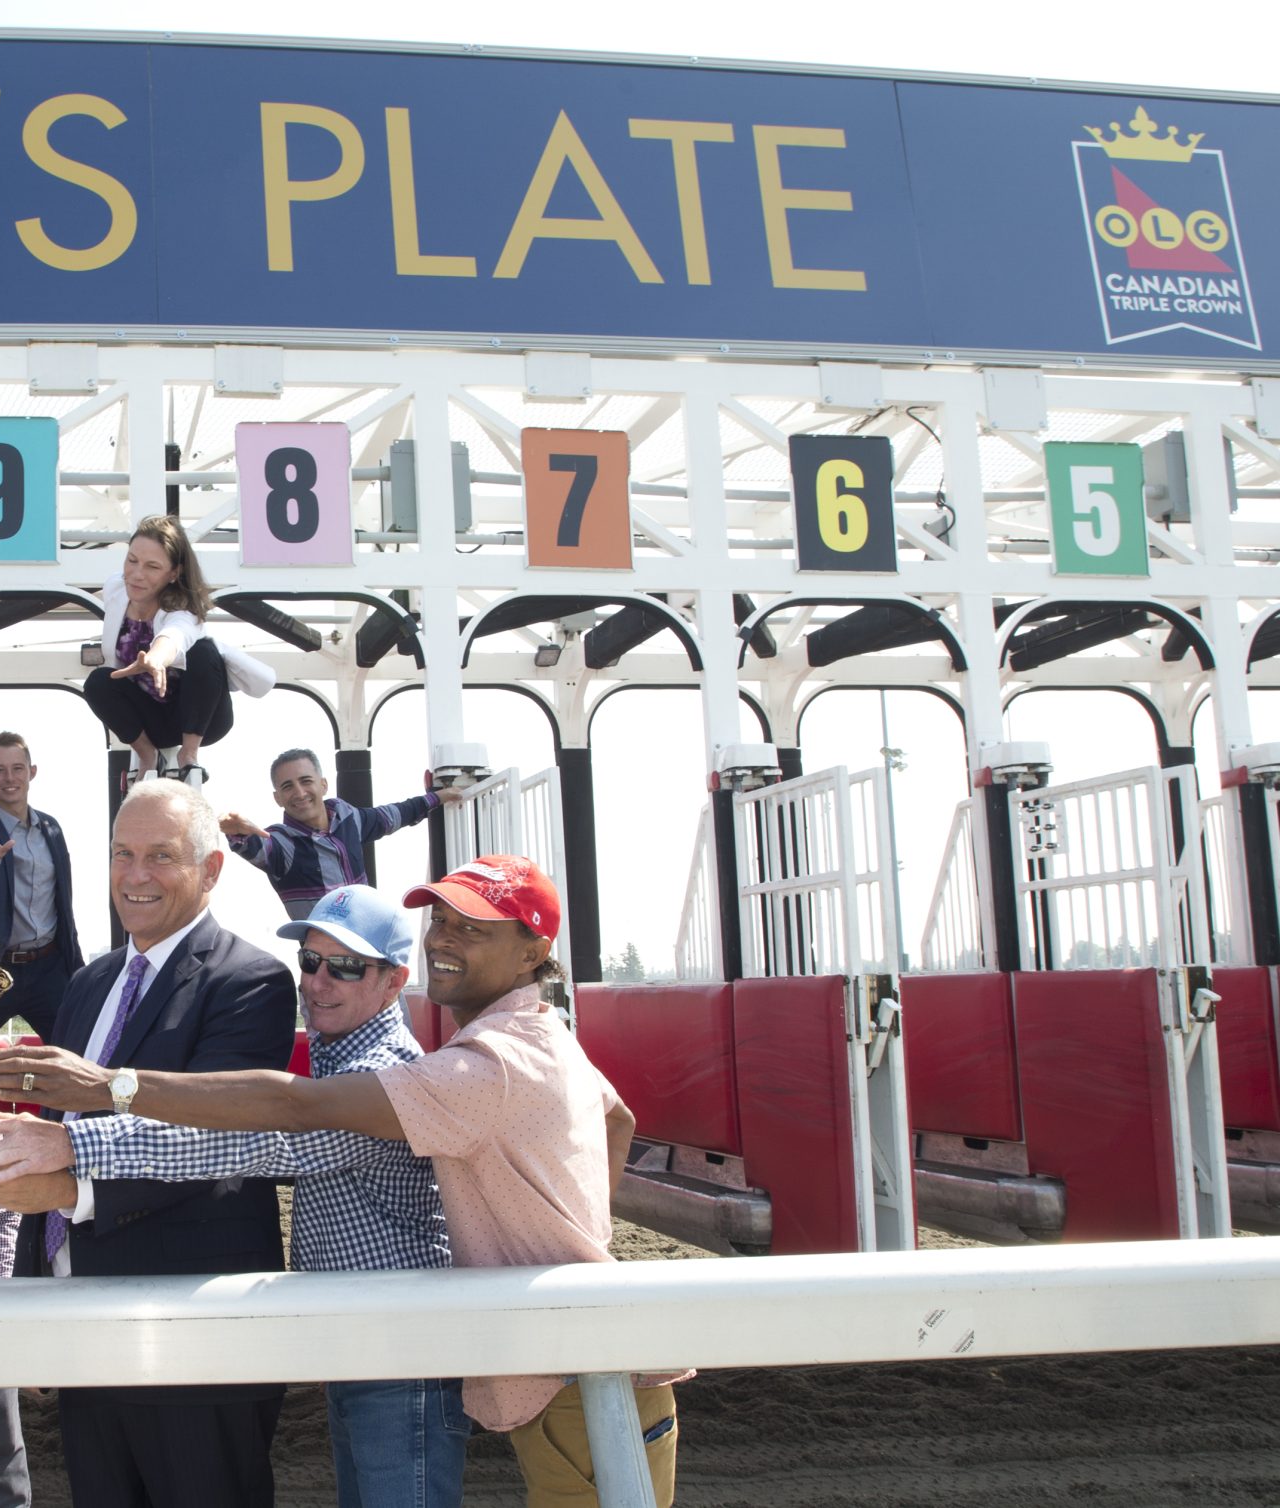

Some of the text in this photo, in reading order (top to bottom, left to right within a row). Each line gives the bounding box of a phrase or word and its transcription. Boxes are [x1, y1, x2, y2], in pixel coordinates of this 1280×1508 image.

[260, 102, 867, 291] PLATE
[1100, 209, 1225, 248] OLG
[1105, 273, 1241, 298] CANADIAN
[1109, 295, 1243, 315] TRIPLE CROWN
[264, 447, 320, 544] 8
[548, 453, 598, 547] 7
[815, 458, 869, 553] 6
[1069, 465, 1122, 557] 5
